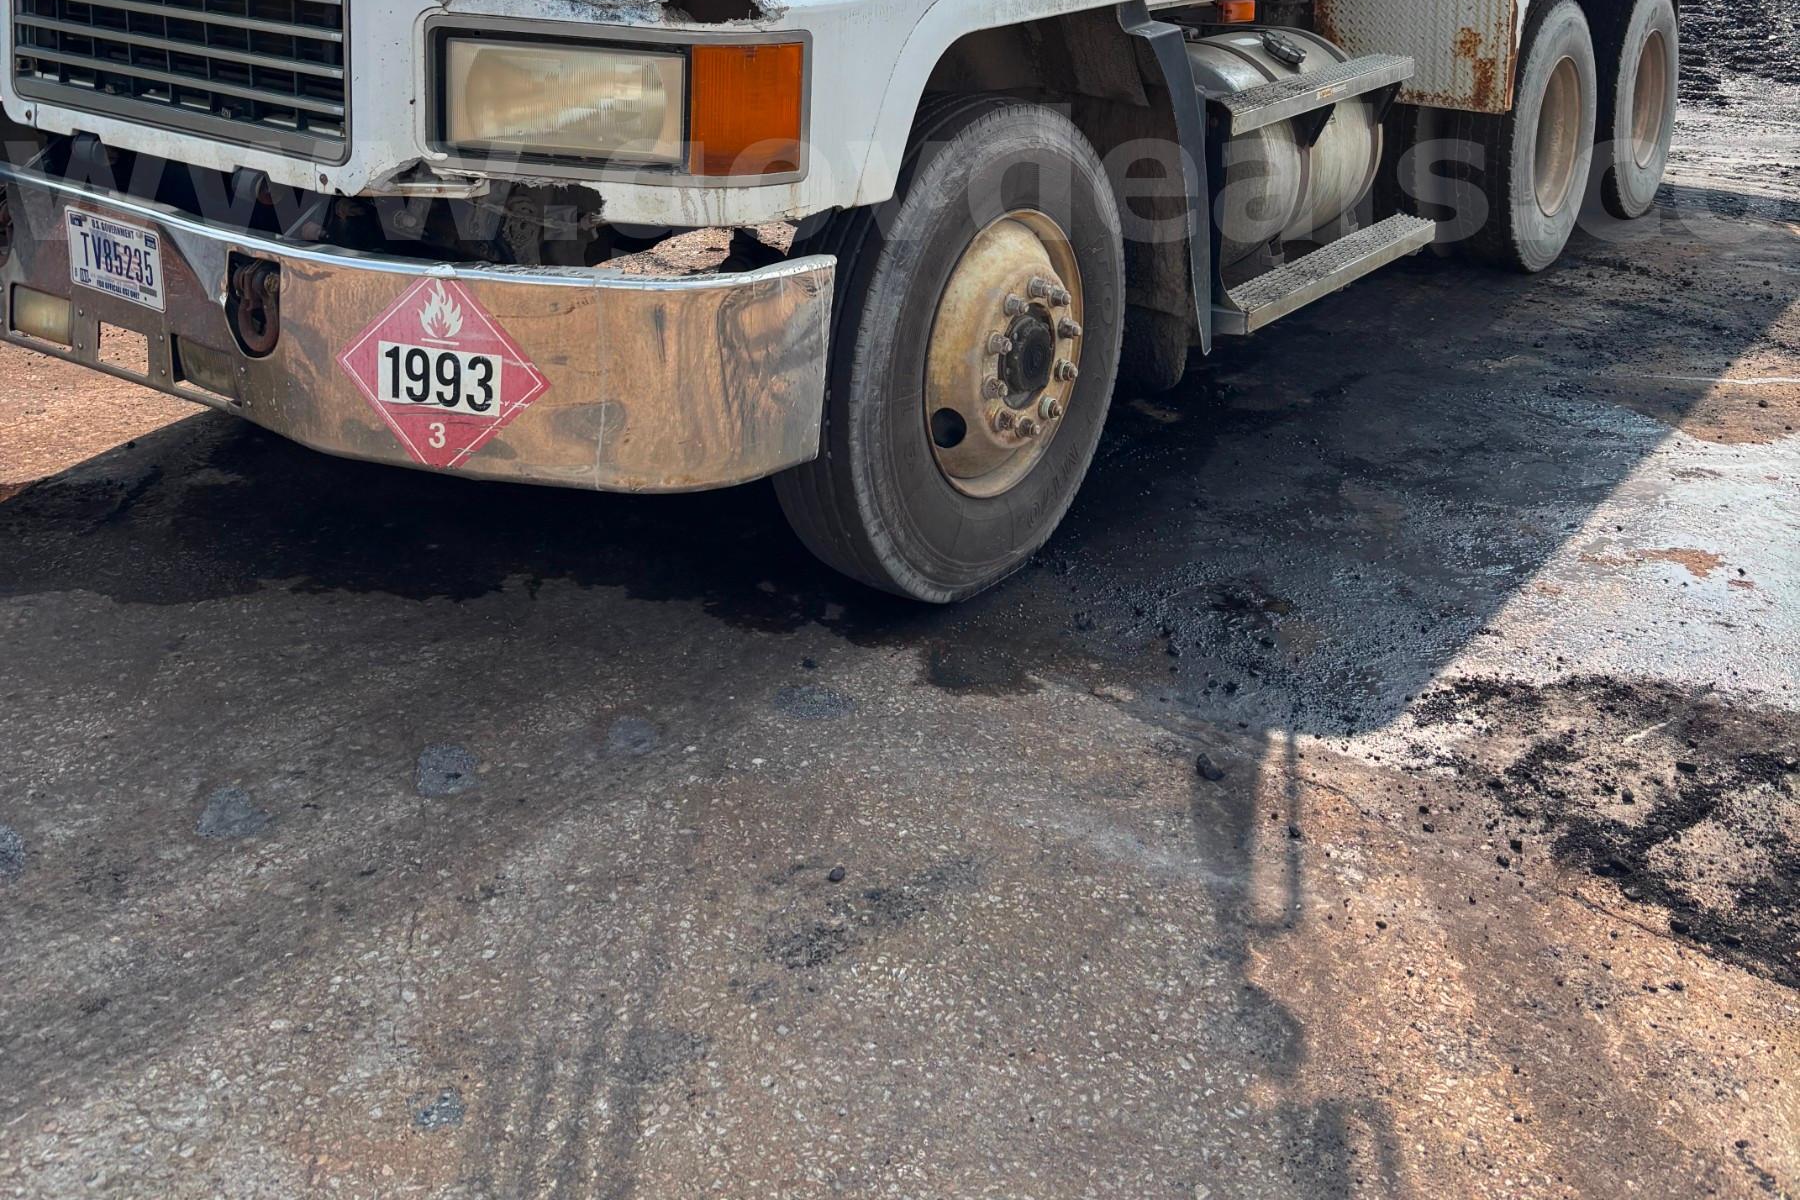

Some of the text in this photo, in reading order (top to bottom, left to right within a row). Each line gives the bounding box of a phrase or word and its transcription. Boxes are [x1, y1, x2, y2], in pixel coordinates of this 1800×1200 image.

[101, 222, 135, 240] GOVERNMENT
[80, 231, 153, 287] TV85235
[385, 346, 494, 412] 1993
[428, 422, 446, 448] 3
